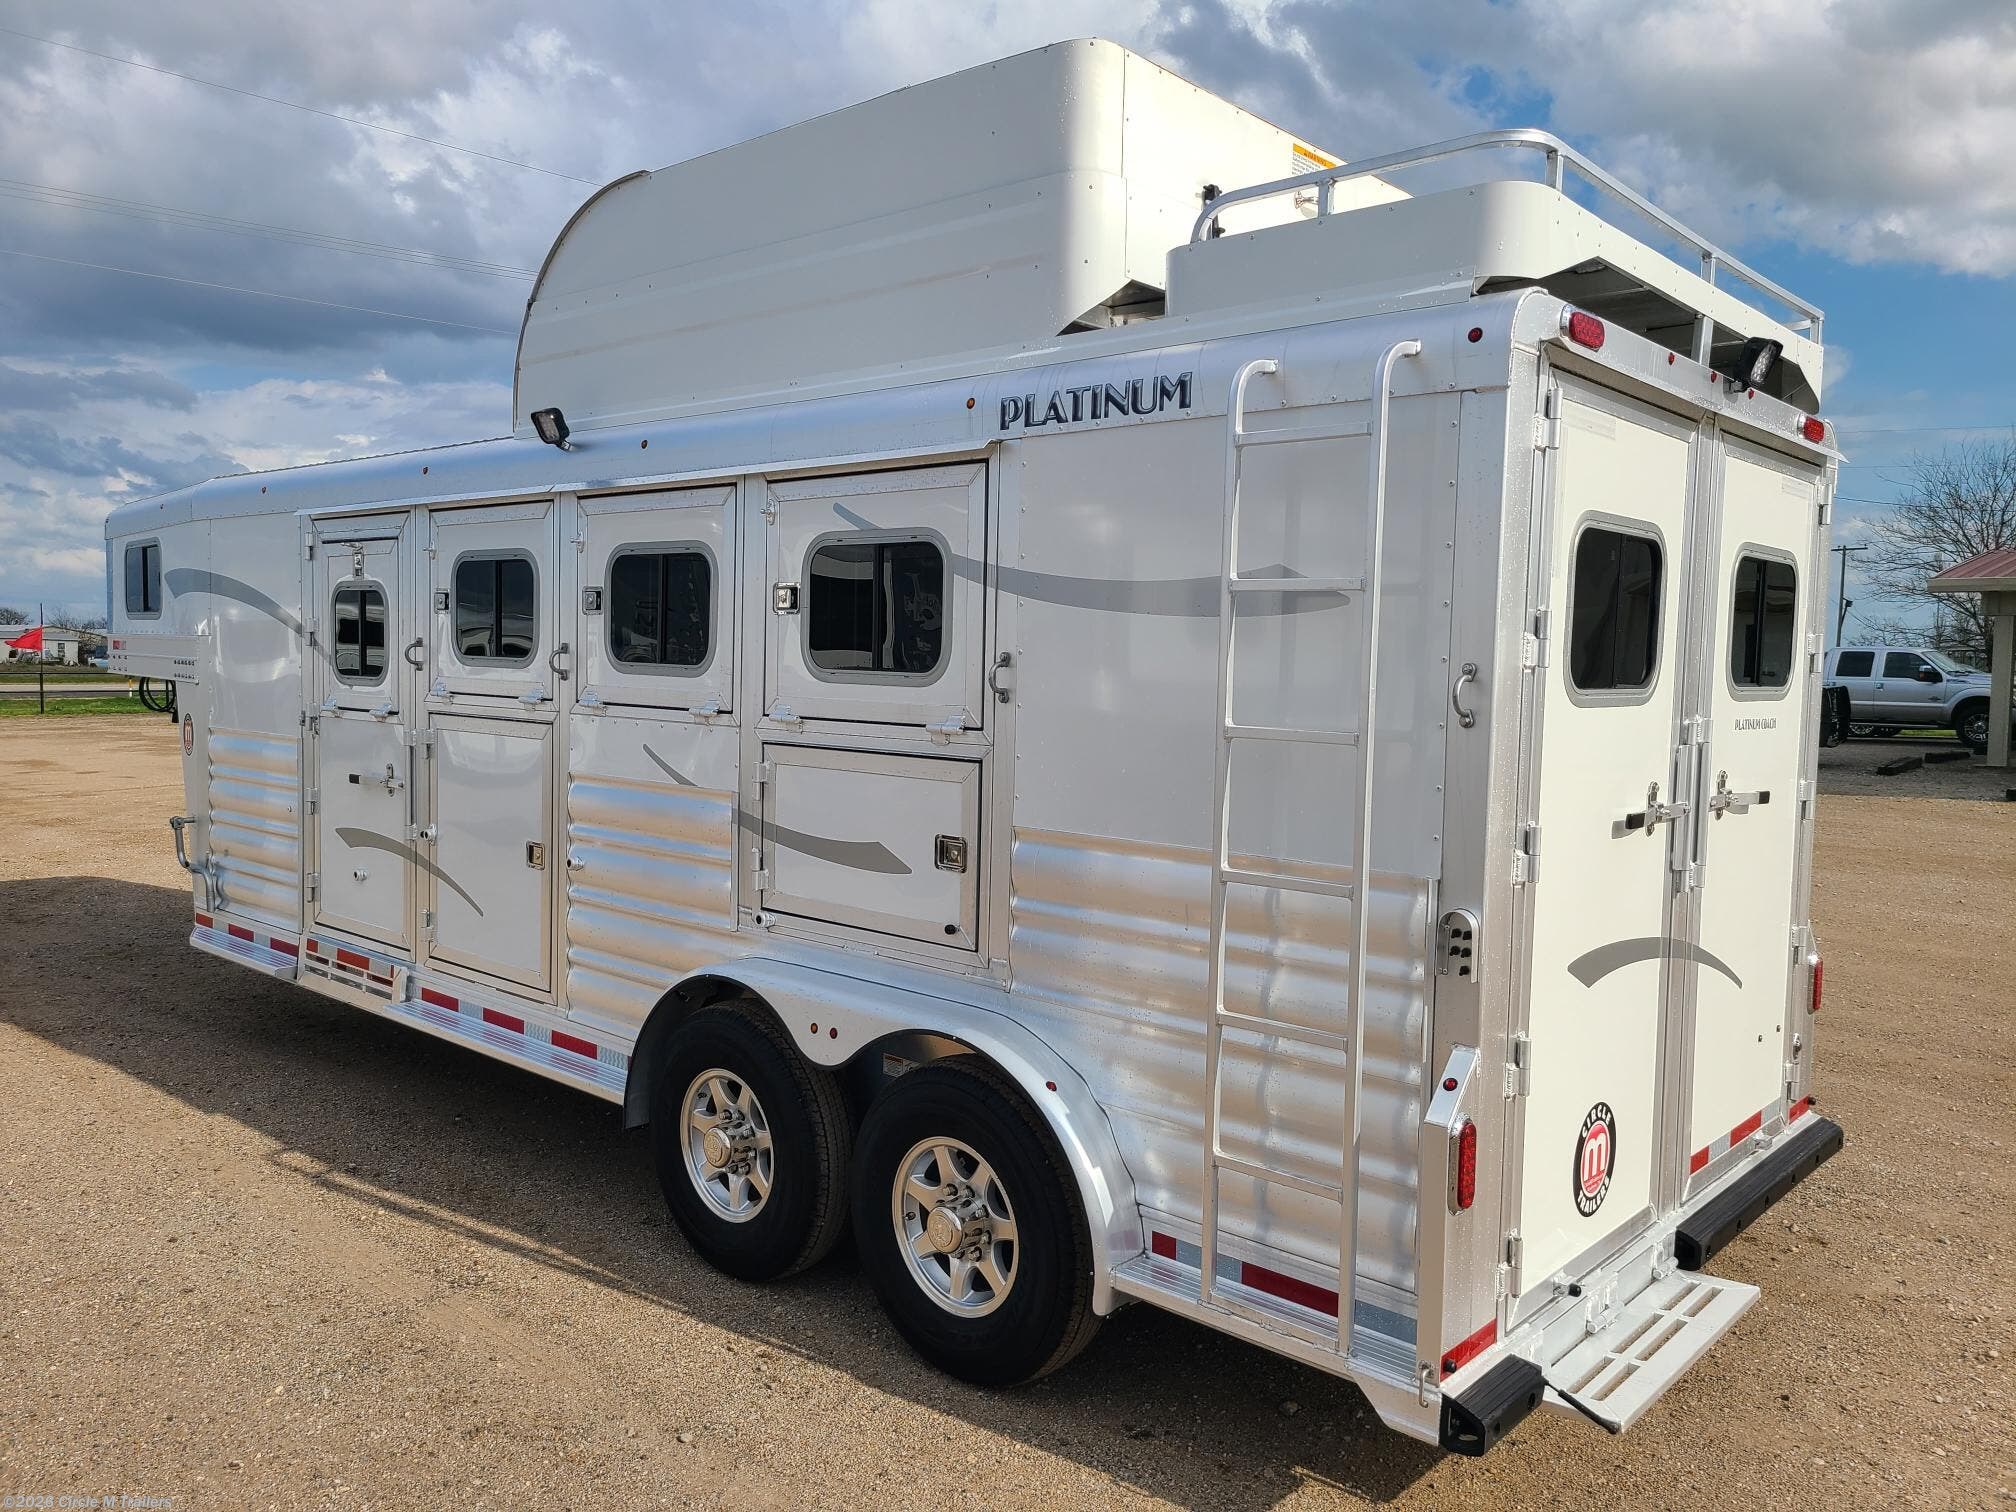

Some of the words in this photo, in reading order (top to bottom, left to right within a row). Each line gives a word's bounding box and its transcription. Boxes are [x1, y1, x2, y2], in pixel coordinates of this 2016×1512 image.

[1000, 372, 1192, 430] PLATINUM
[1582, 1105, 1611, 1138] CIRCLE
[1578, 1176, 1609, 1214] TRAILERS
